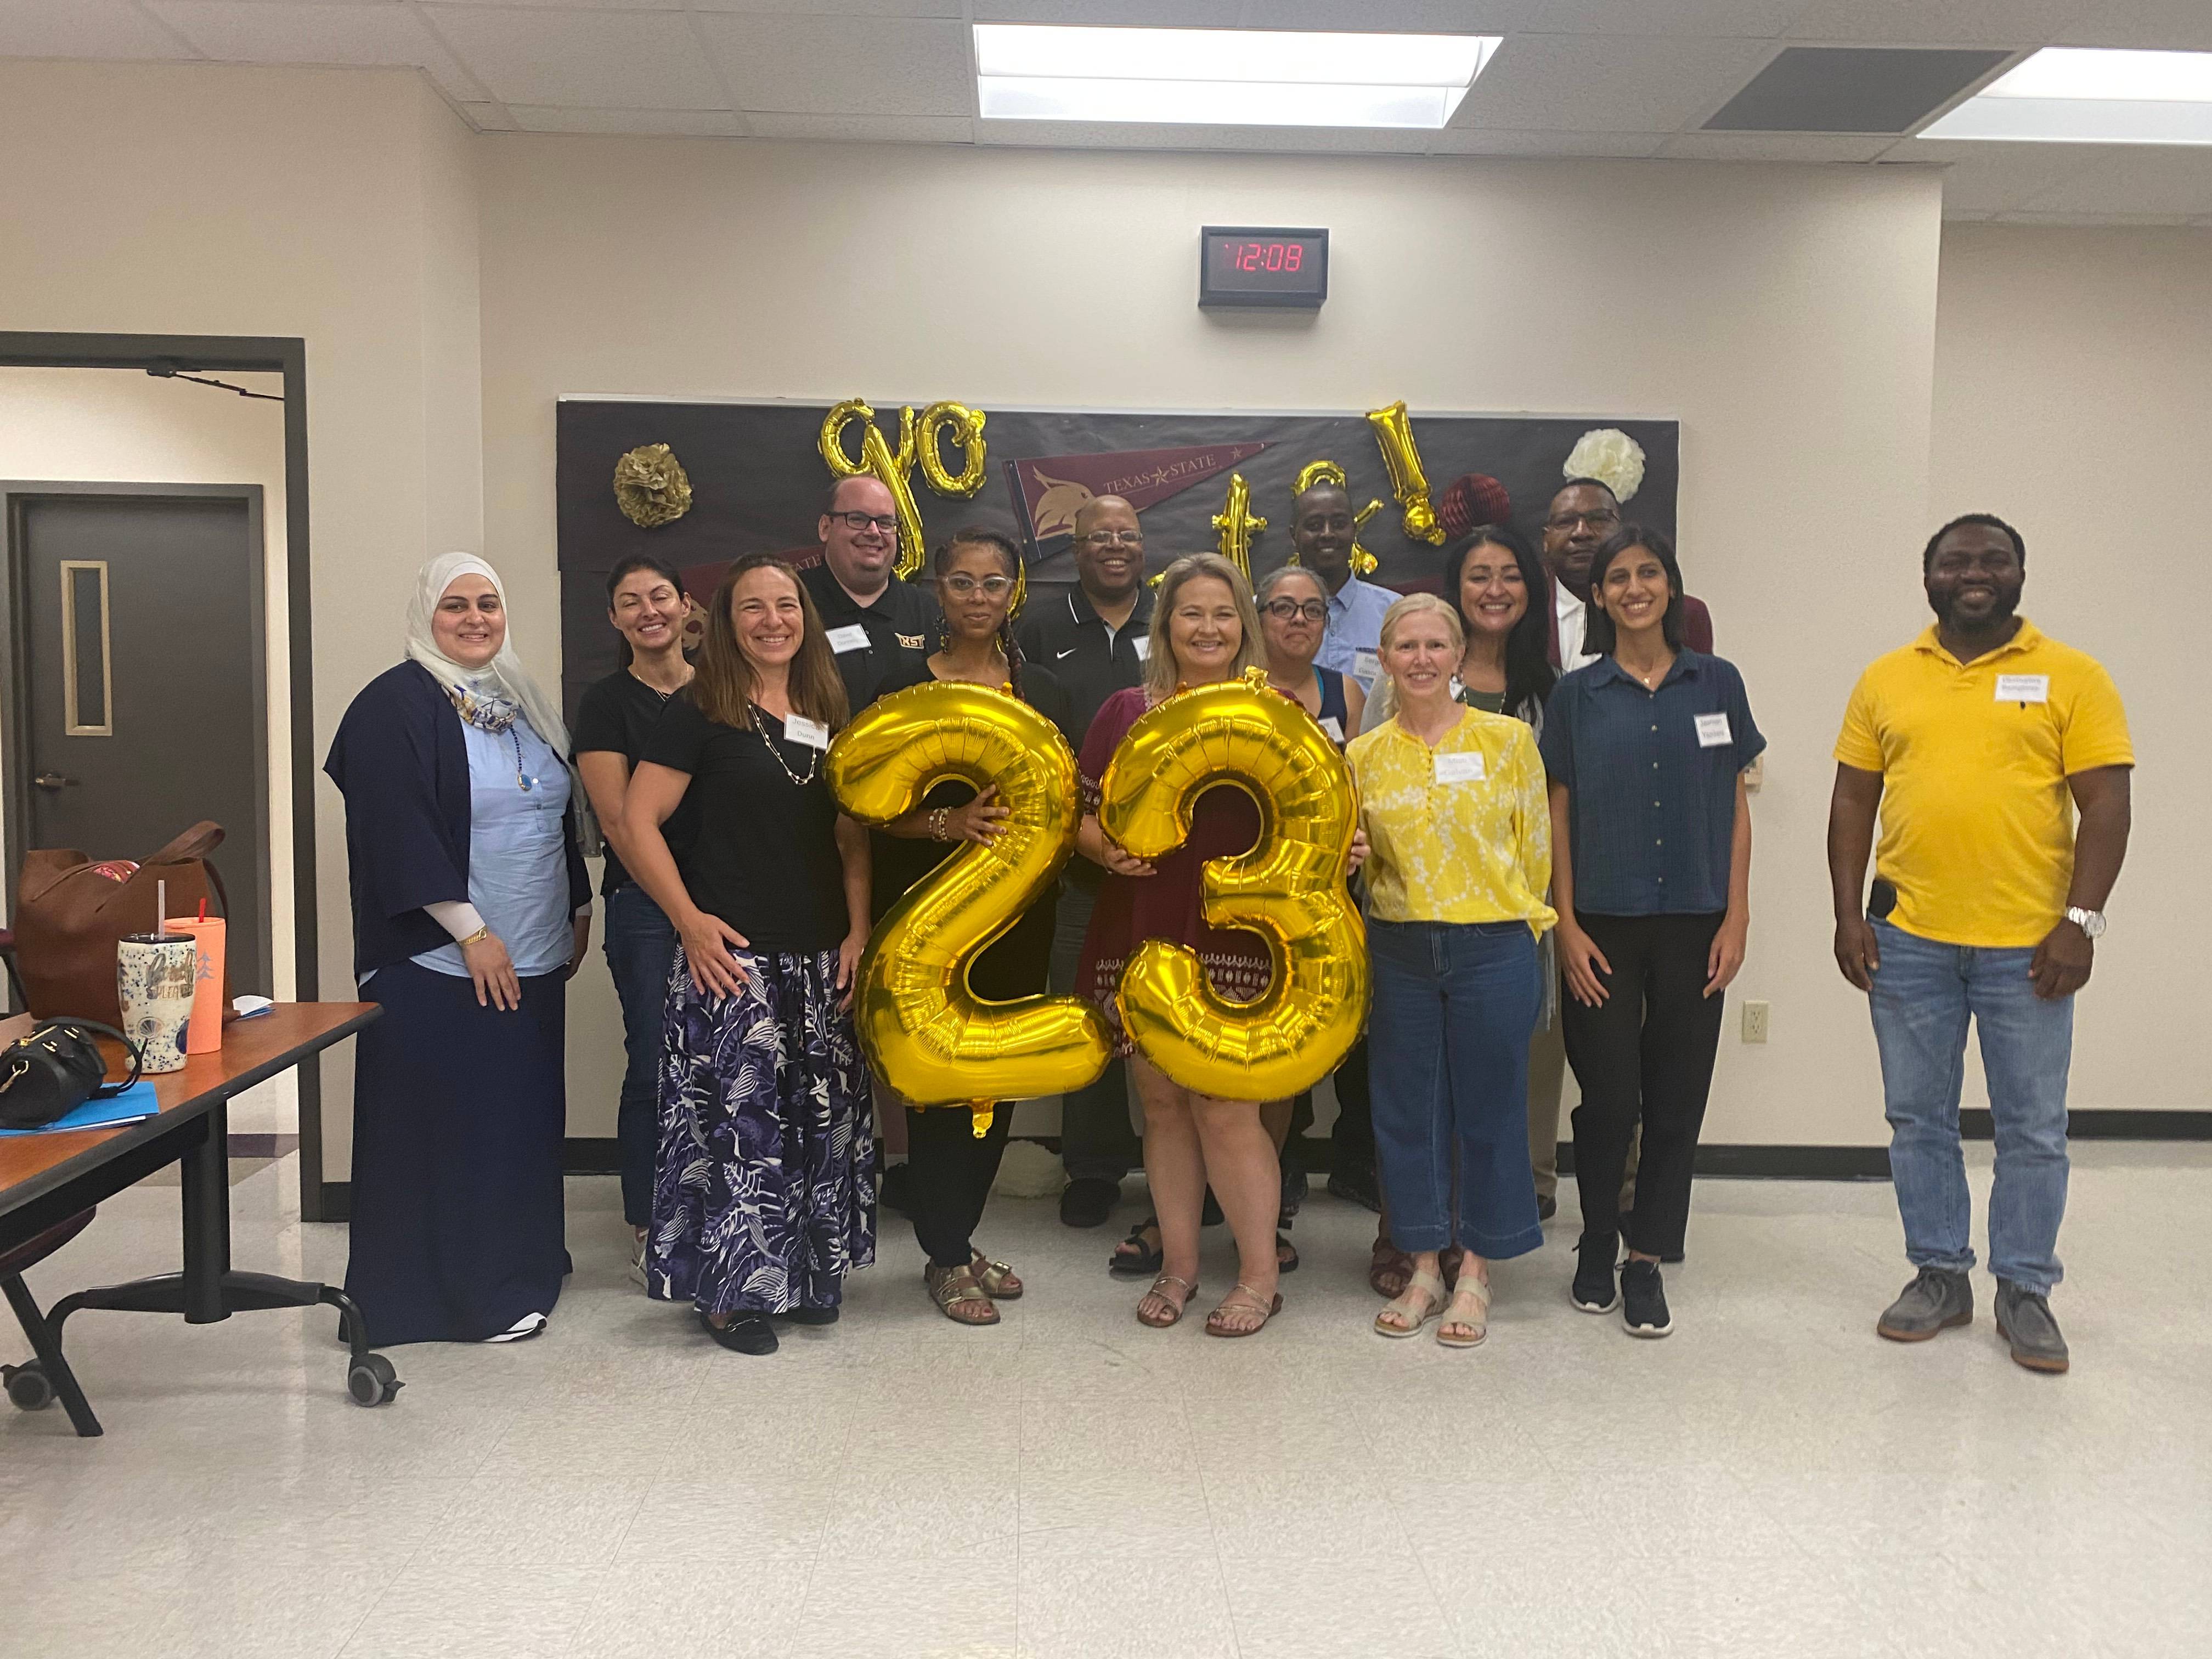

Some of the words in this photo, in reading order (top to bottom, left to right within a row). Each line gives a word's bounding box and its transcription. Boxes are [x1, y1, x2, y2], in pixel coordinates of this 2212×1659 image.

[1235, 243, 1304, 272] 12:08
[1103, 471, 1151, 494] TEXAS
[1170, 453, 1216, 477] STATE
[794, 554, 822, 571] ATE
[797, 730, 815, 741] Dunn
